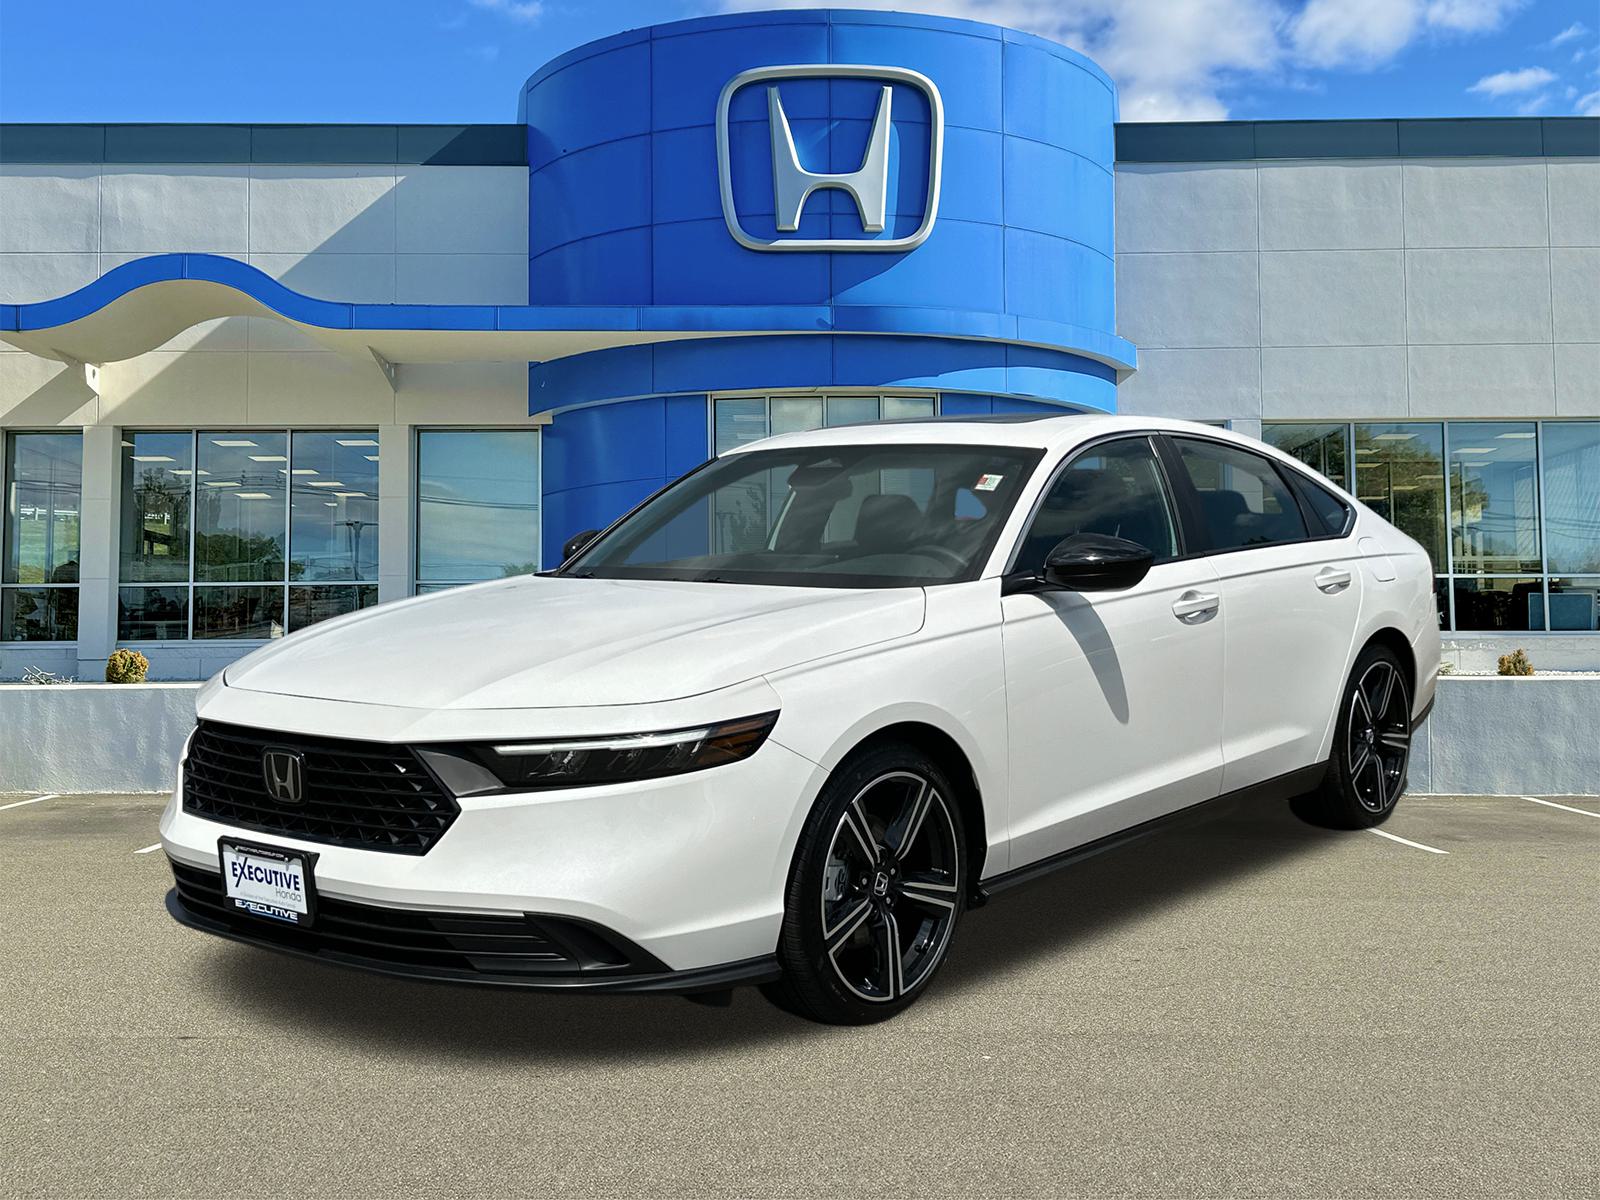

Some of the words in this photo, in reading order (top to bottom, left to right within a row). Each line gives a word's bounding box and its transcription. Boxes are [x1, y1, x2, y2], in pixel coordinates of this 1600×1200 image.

[231, 857, 300, 891] EXECUTIVE
[275, 888, 302, 902] Honda
[234, 899, 298, 920] EXECUTIVE
